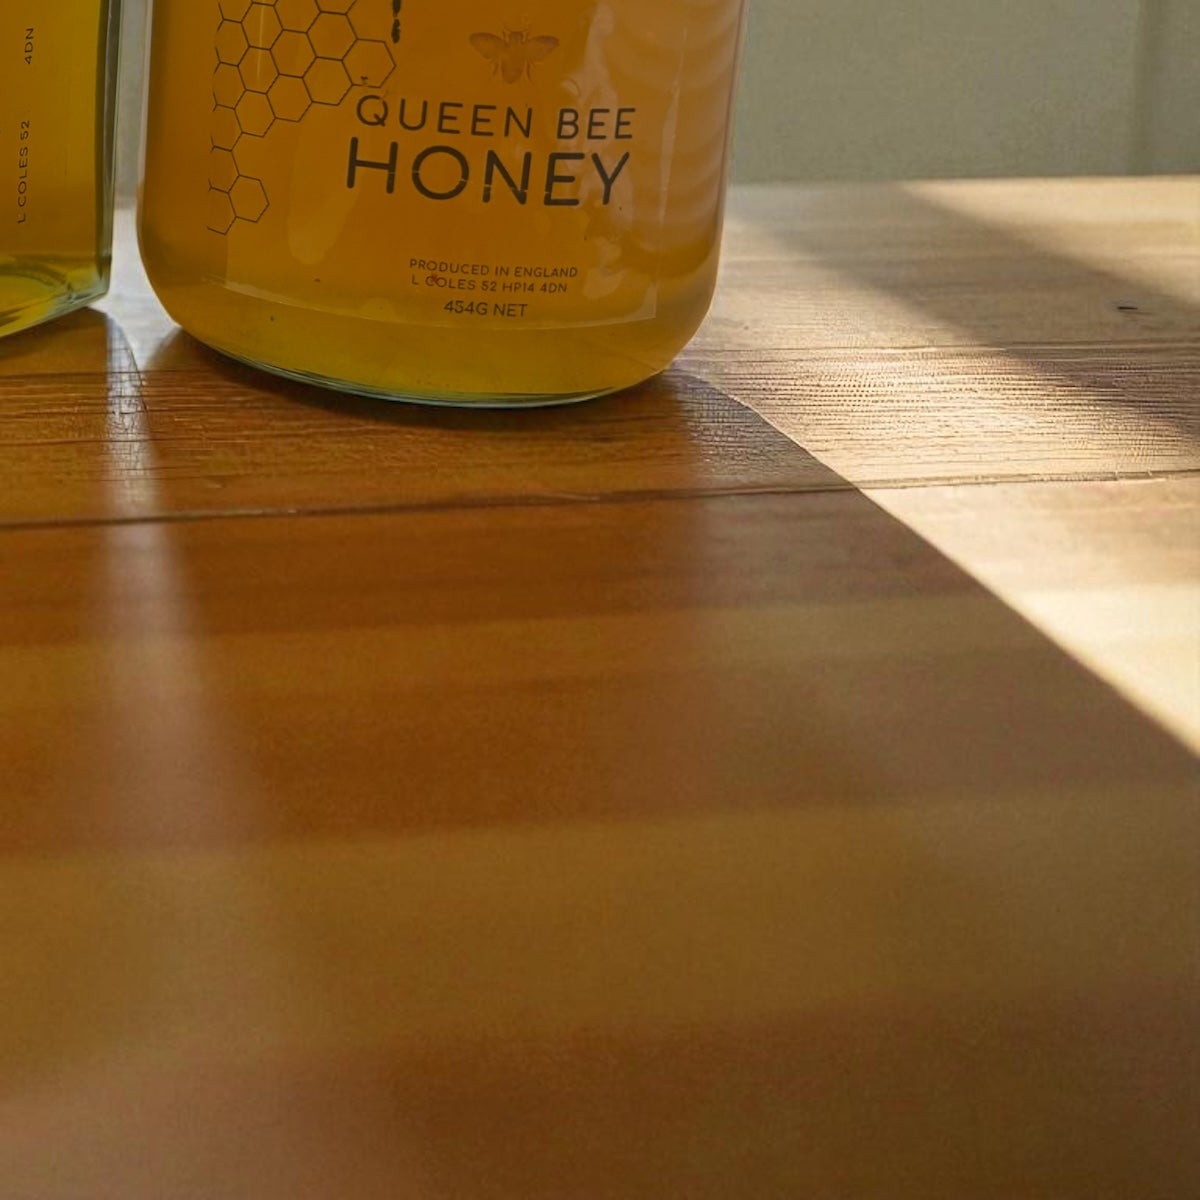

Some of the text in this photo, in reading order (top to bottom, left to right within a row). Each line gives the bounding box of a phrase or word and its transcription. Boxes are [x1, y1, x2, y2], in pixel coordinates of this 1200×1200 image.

[17, 146, 28, 208] COLES
[24, 27, 34, 65] 4DN
[355, 94, 636, 140] QUEEN BEE
[347, 136, 631, 207] HONEY
[409, 258, 578, 278] PRODUCED IN ENGLAND
[411, 274, 419, 286] L
[425, 275, 476, 290] COLES
[502, 282, 535, 293] HP14
[540, 282, 568, 294] 4DN
[444, 300, 528, 317] 454G NET
